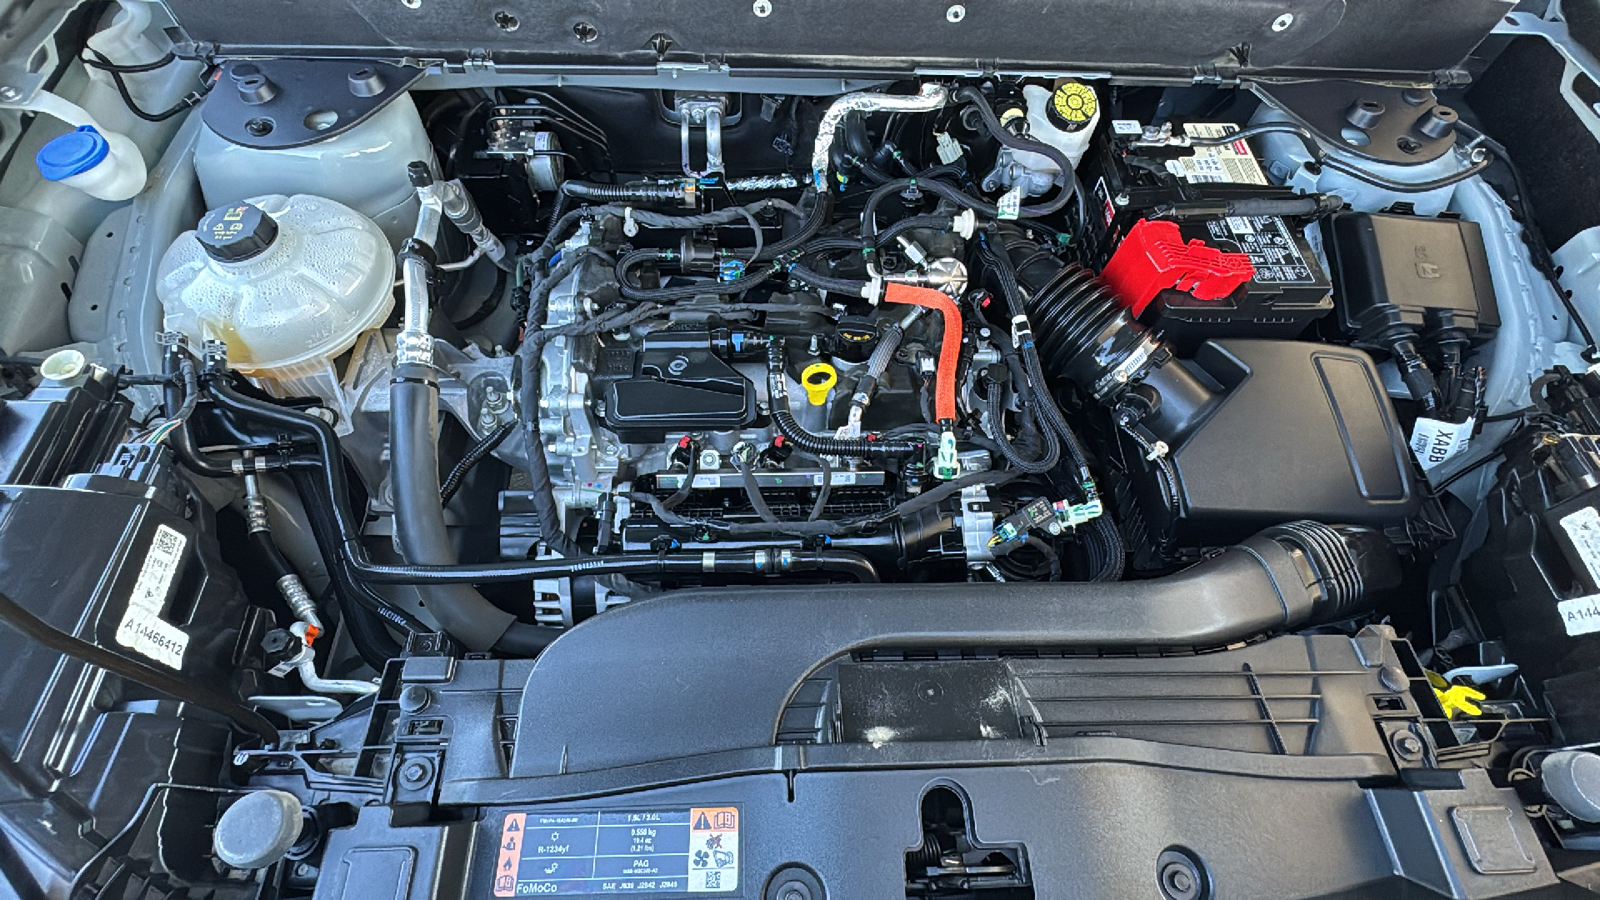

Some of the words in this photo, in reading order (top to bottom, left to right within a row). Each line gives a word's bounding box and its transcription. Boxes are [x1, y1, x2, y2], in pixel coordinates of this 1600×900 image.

[124, 618, 183, 656] A14466412
[537, 844, 570, 855] R-1234yf
[633, 859, 650, 868] PAG
[516, 882, 558, 894] FoMoCo
[602, 882, 617, 890] SAE
